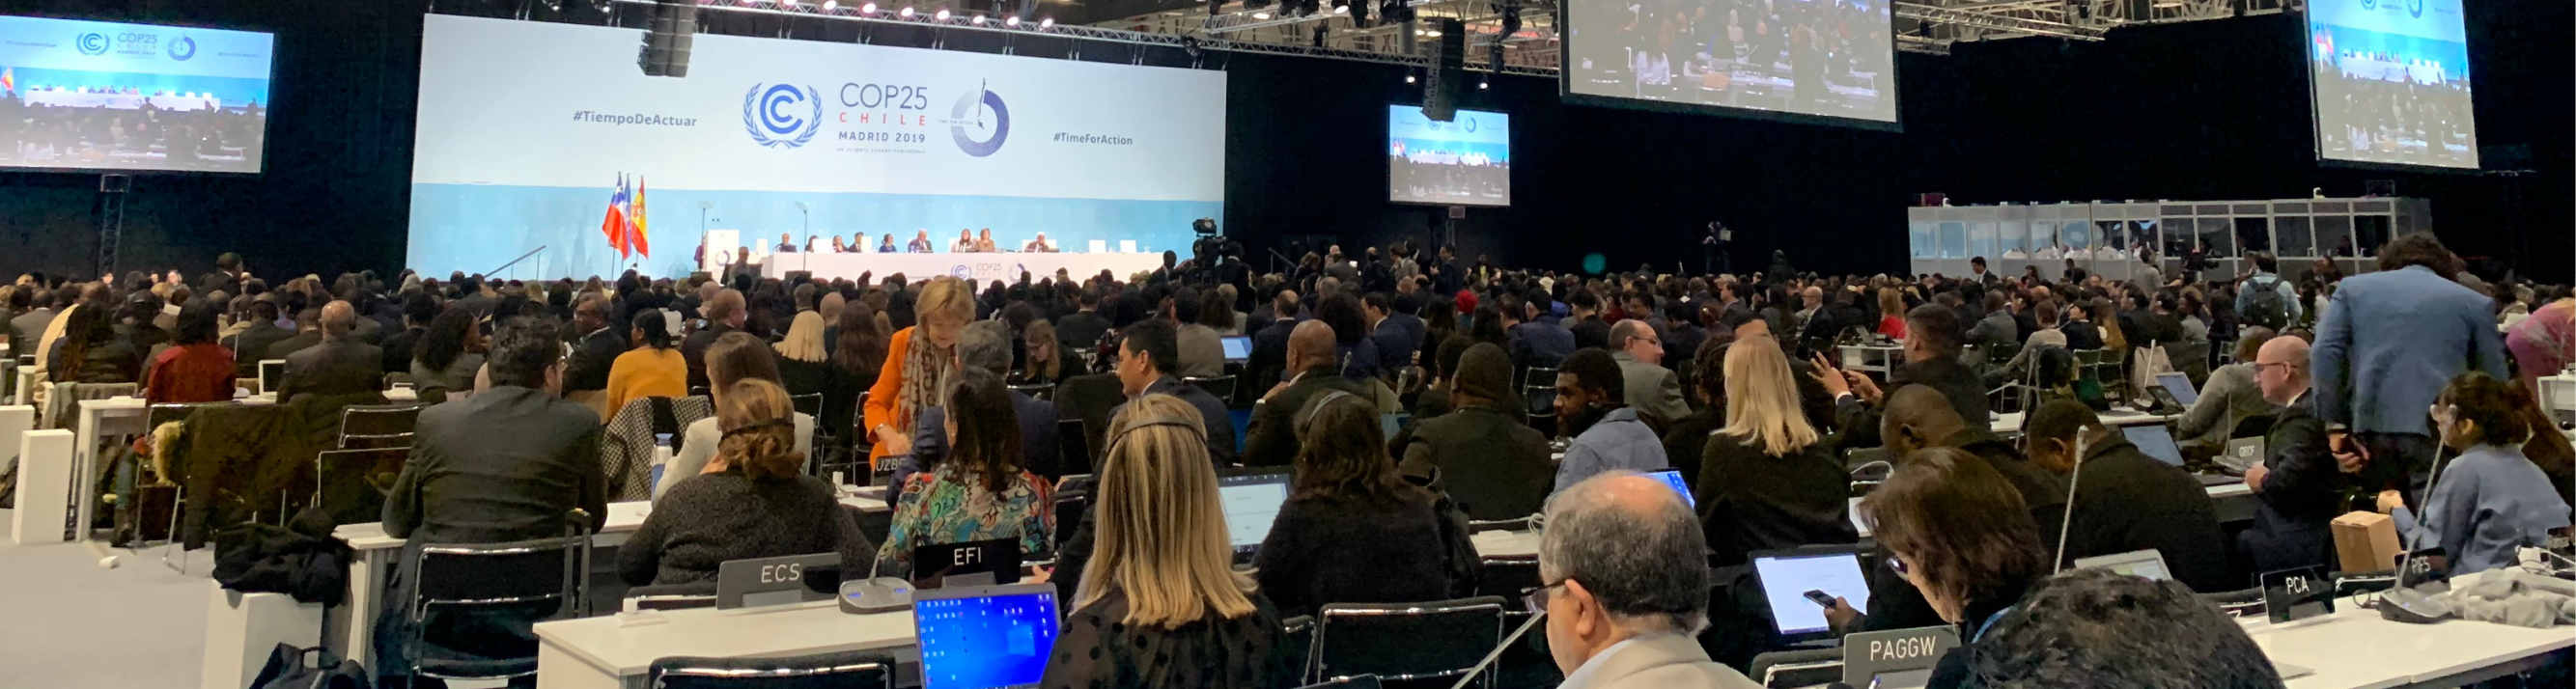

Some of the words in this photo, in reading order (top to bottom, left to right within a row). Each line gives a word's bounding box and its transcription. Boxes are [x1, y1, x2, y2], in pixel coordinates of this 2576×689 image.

[117, 32, 158, 44] COP25
[840, 82, 928, 110] COP25
[573, 110, 697, 126] #TiempoDeActuar
[839, 111, 926, 126] CHILE
[838, 131, 889, 142] MADRID
[895, 132, 925, 143] 2019
[1053, 132, 1133, 145] #TimeForAction
[976, 262, 1002, 271] COP25
[954, 547, 981, 565] EFI
[2411, 556, 2431, 573] PIFS
[761, 563, 800, 583] ECS
[2285, 576, 2310, 594] PCA
[1870, 635, 1936, 662] PAGGW
